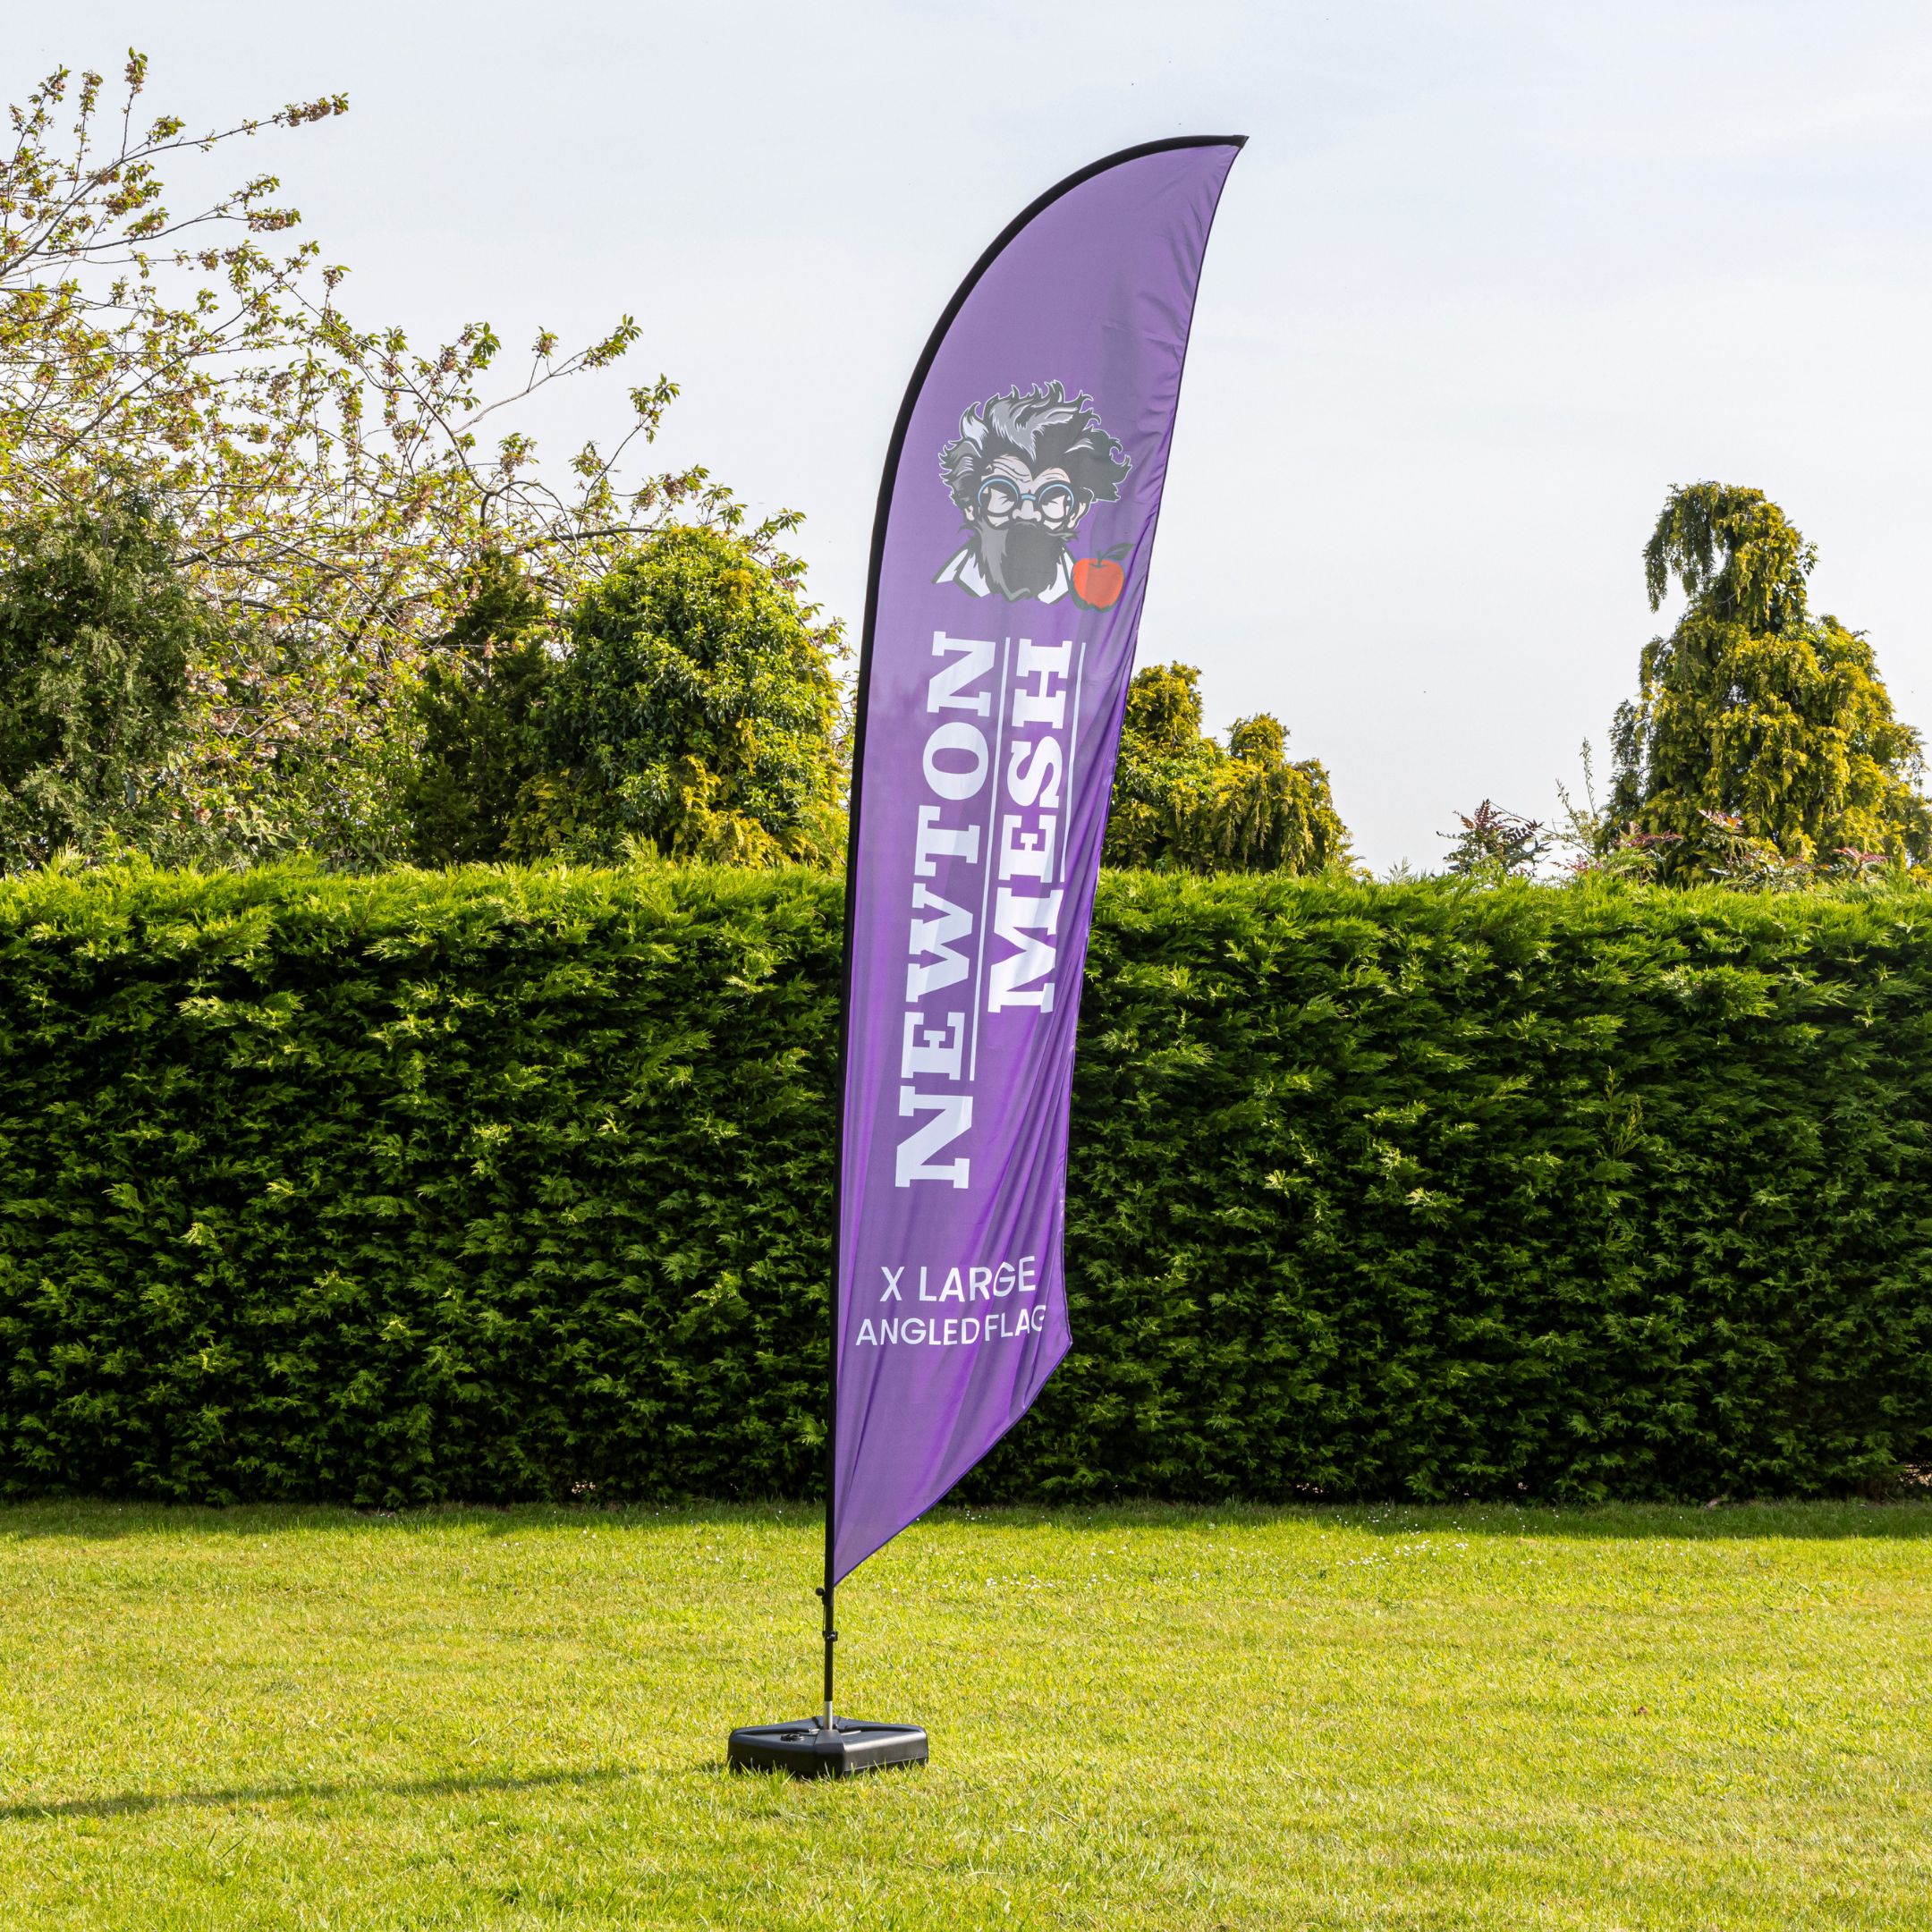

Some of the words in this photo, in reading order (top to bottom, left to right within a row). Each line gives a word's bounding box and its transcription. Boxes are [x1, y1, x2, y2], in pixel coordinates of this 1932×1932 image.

[895, 631, 996, 1189] NEWTON
[987, 639, 1072, 1013] MESH
[855, 1318, 980, 1346] ANGLED
[880, 1266, 905, 1302] X
[919, 1255, 1036, 1302] LARGE
